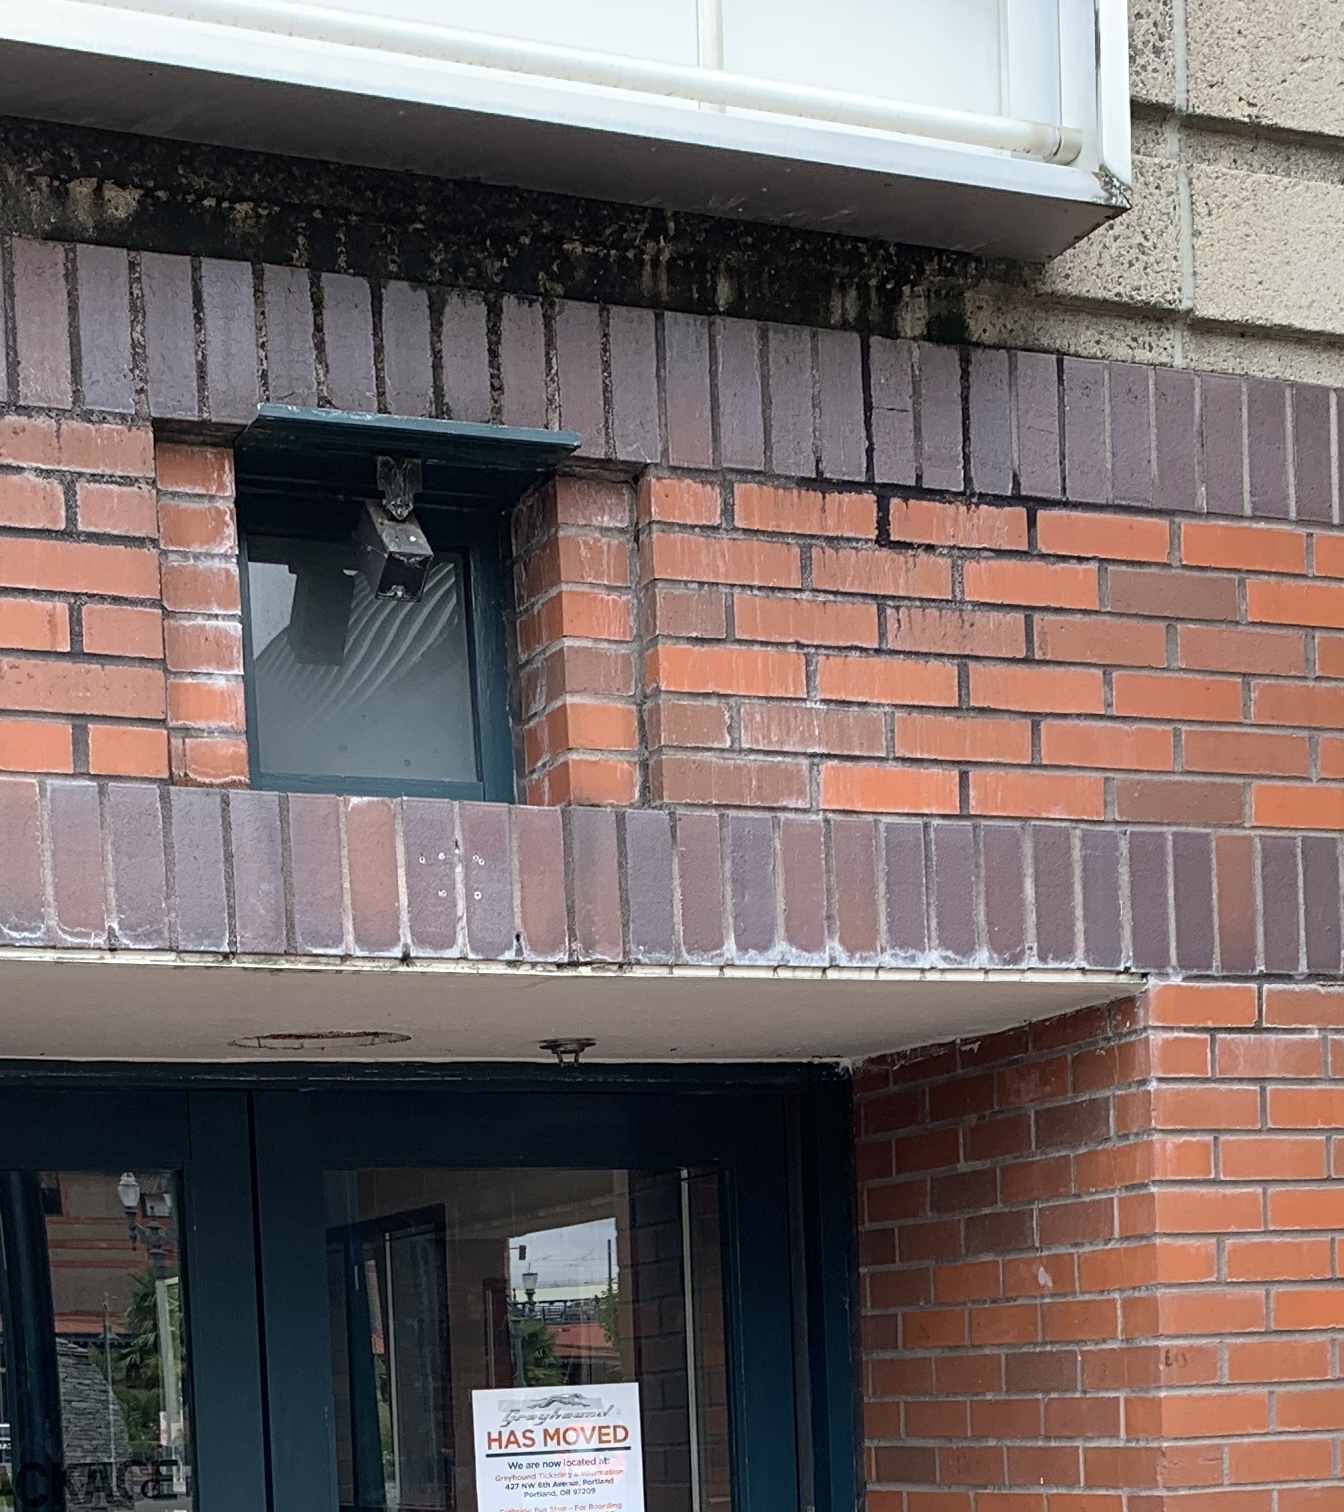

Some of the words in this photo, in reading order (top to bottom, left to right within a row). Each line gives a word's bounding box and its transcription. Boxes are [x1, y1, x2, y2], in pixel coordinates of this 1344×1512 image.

[500, 1405, 614, 1427] Greyhound
[487, 1429, 536, 1450] HAS
[543, 1425, 629, 1447] MOVED
[507, 1461, 523, 1470] We
[563, 1457, 596, 1467] located
[598, 1457, 611, 1465] at:
[495, 1472, 536, 1482] Greyhound
[539, 1471, 572, 1479] Ticketing
[583, 1478, 615, 1486] Portland
[524, 1490, 558, 1498] Portland,
[573, 1487, 596, 1496] 97209
[550, 1505, 567, 1512] Stop
[588, 1502, 622, 1511] Boarding
